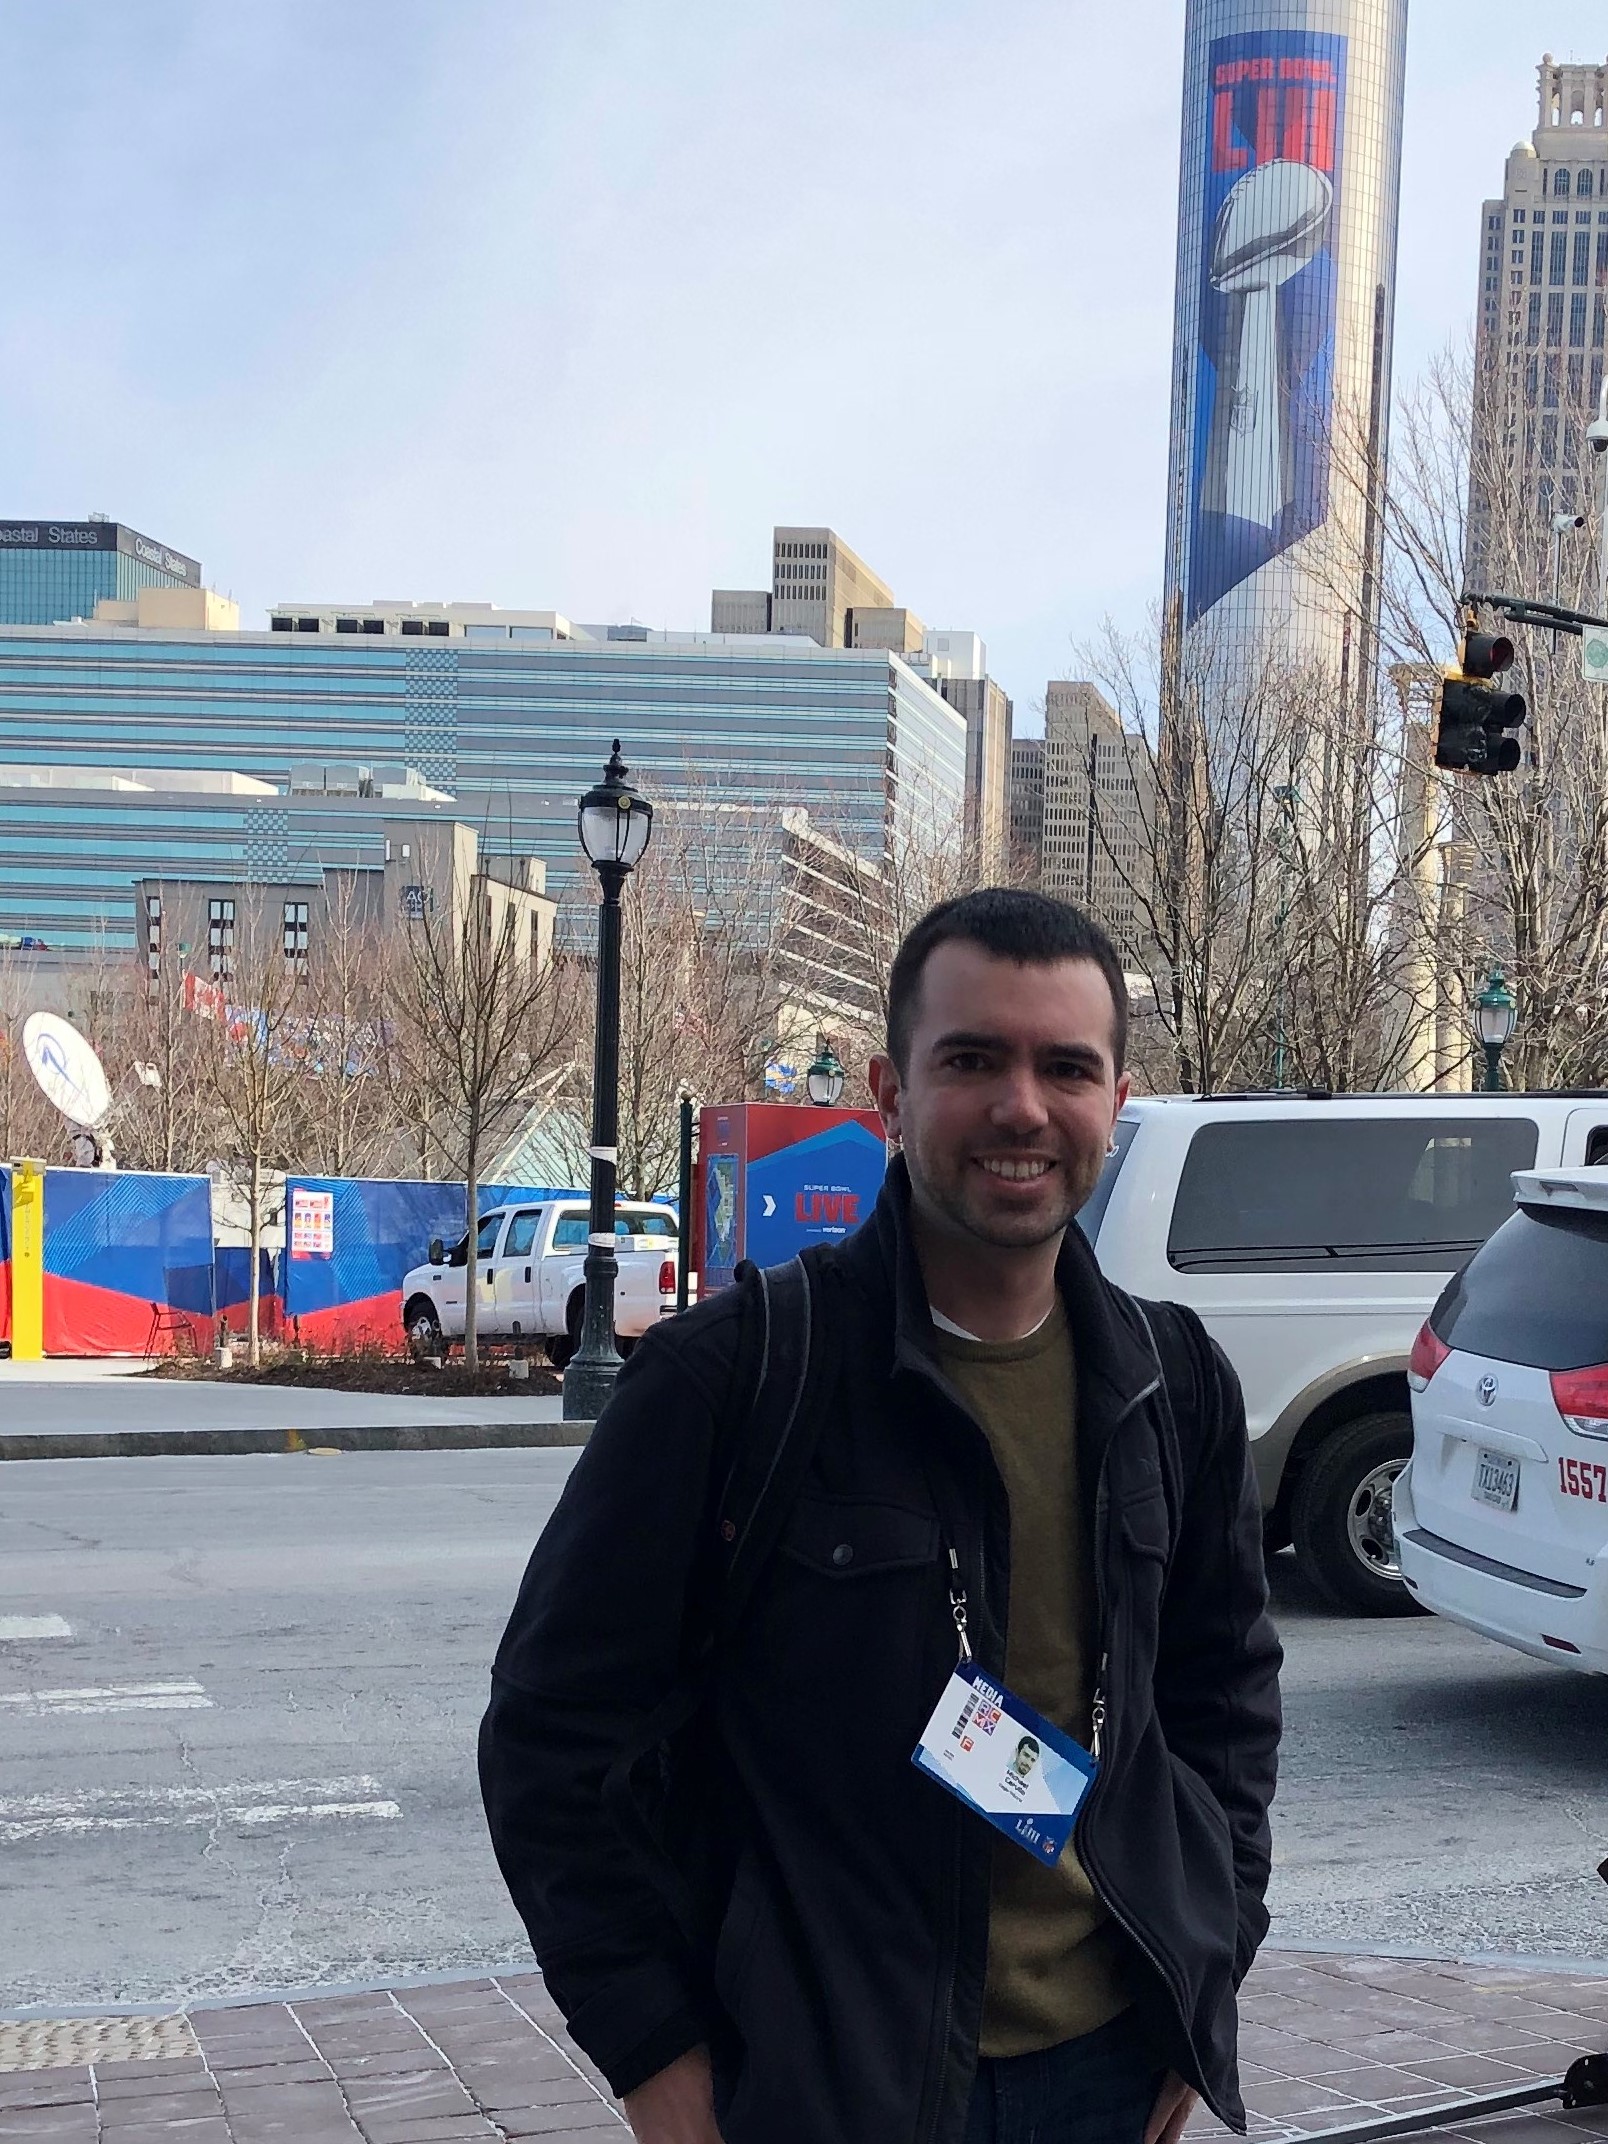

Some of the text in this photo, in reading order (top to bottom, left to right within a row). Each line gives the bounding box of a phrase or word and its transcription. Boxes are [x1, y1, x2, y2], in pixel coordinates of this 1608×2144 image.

[1215, 57, 1337, 86] SUPER BOWL
[0, 526, 98, 544] astal States
[135, 537, 187, 577] Coastal States
[803, 1184, 852, 1193] SUPER BOWL
[795, 1192, 861, 1224] LIVE
[822, 1226, 847, 1234] verizon
[1558, 1456, 1607, 1502] 1557
[972, 1675, 1004, 1708] MEDIA
